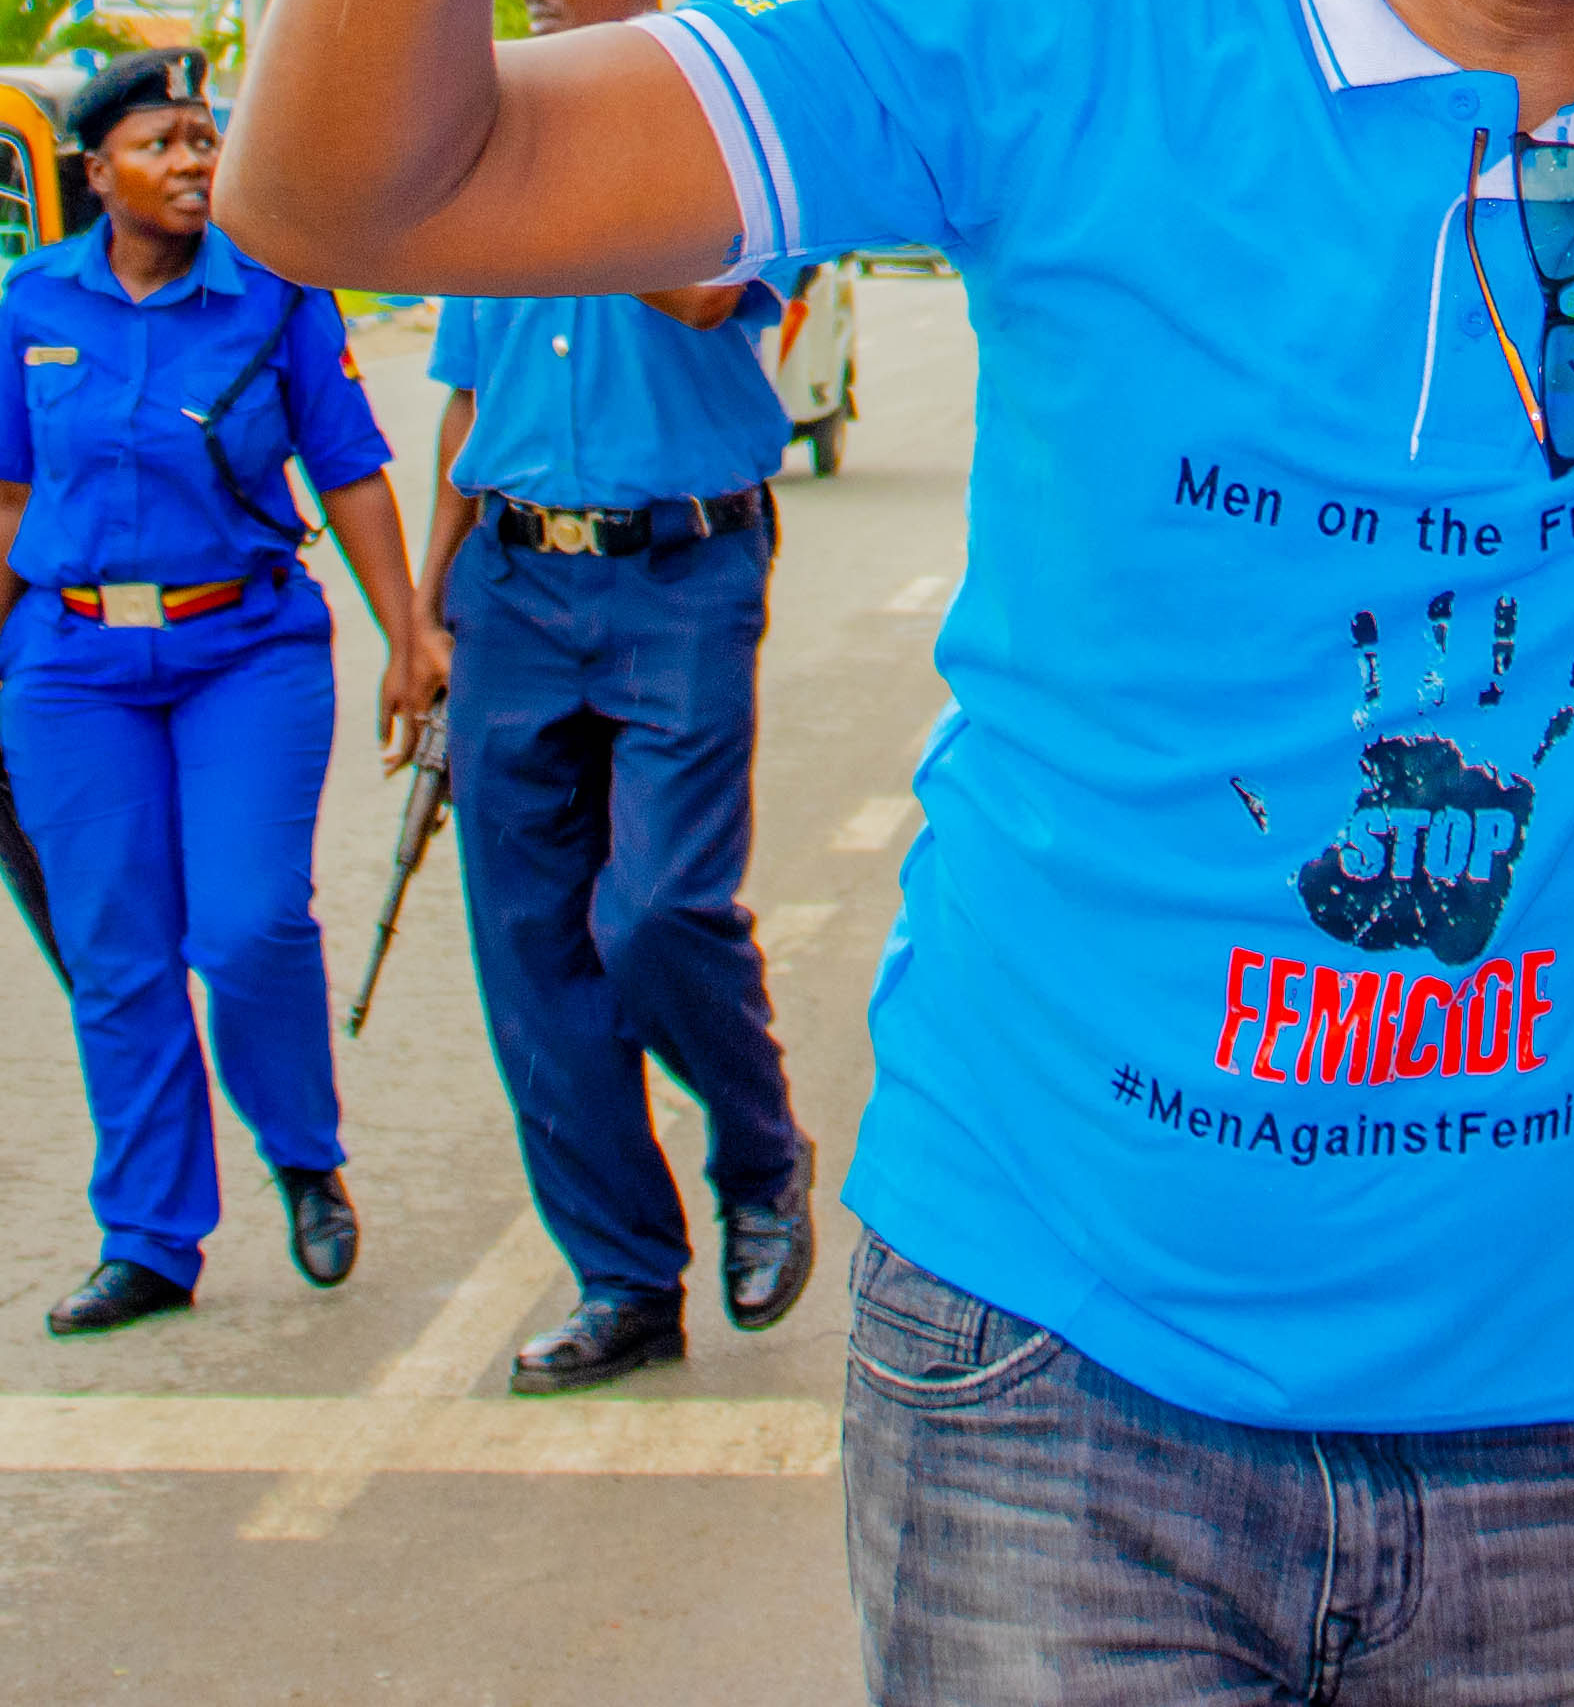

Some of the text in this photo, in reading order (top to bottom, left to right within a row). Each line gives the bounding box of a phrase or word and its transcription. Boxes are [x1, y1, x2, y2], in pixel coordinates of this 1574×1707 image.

[1174, 456, 1283, 527] Men
[1316, 500, 1380, 546] on
[1416, 507, 1502, 557] the
[1338, 807, 1515, 884] STOP
[1213, 945, 1556, 1087] FEMICIDE
